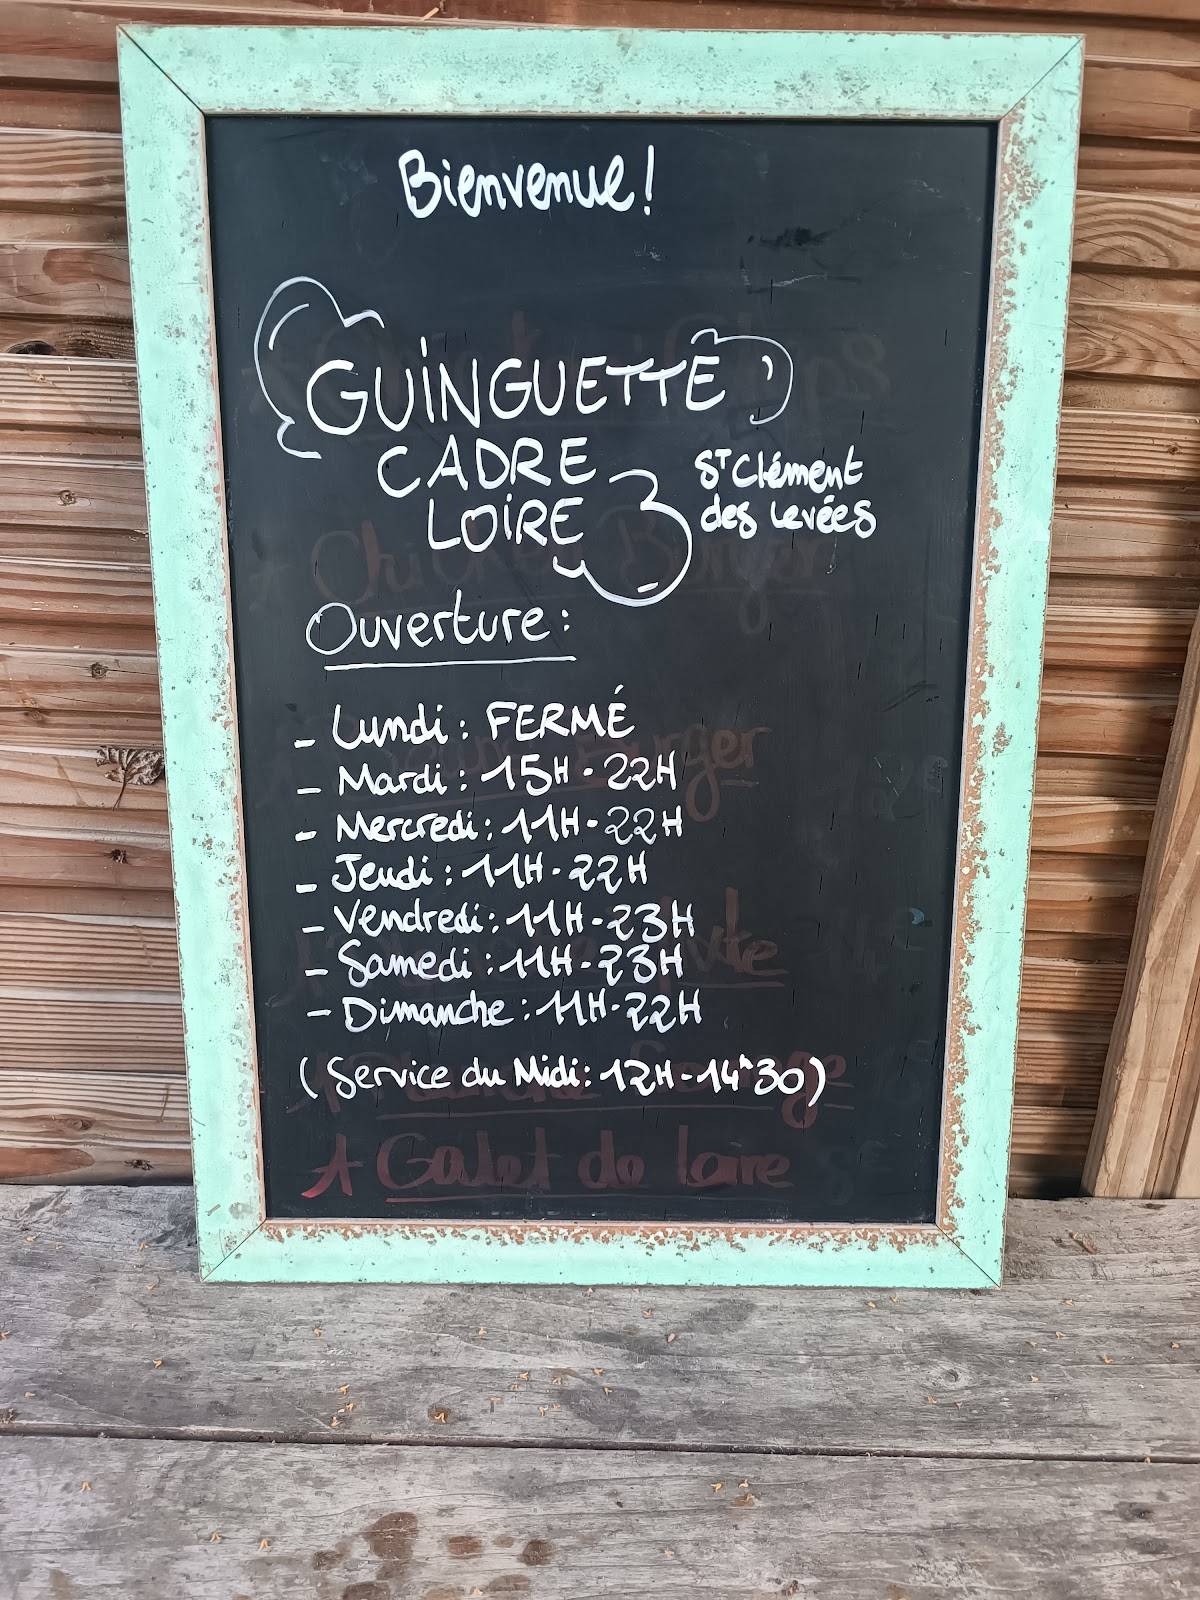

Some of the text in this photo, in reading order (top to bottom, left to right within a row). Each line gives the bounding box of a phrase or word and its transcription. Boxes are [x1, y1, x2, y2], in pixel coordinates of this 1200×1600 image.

[377, 434, 597, 499] CADRE
[731, 444, 864, 494] Clément
[700, 492, 758, 540] des
[485, 683, 636, 742] FERMÉ
[338, 761, 448, 797] Mardi
[461, 1056, 507, 1088] du
